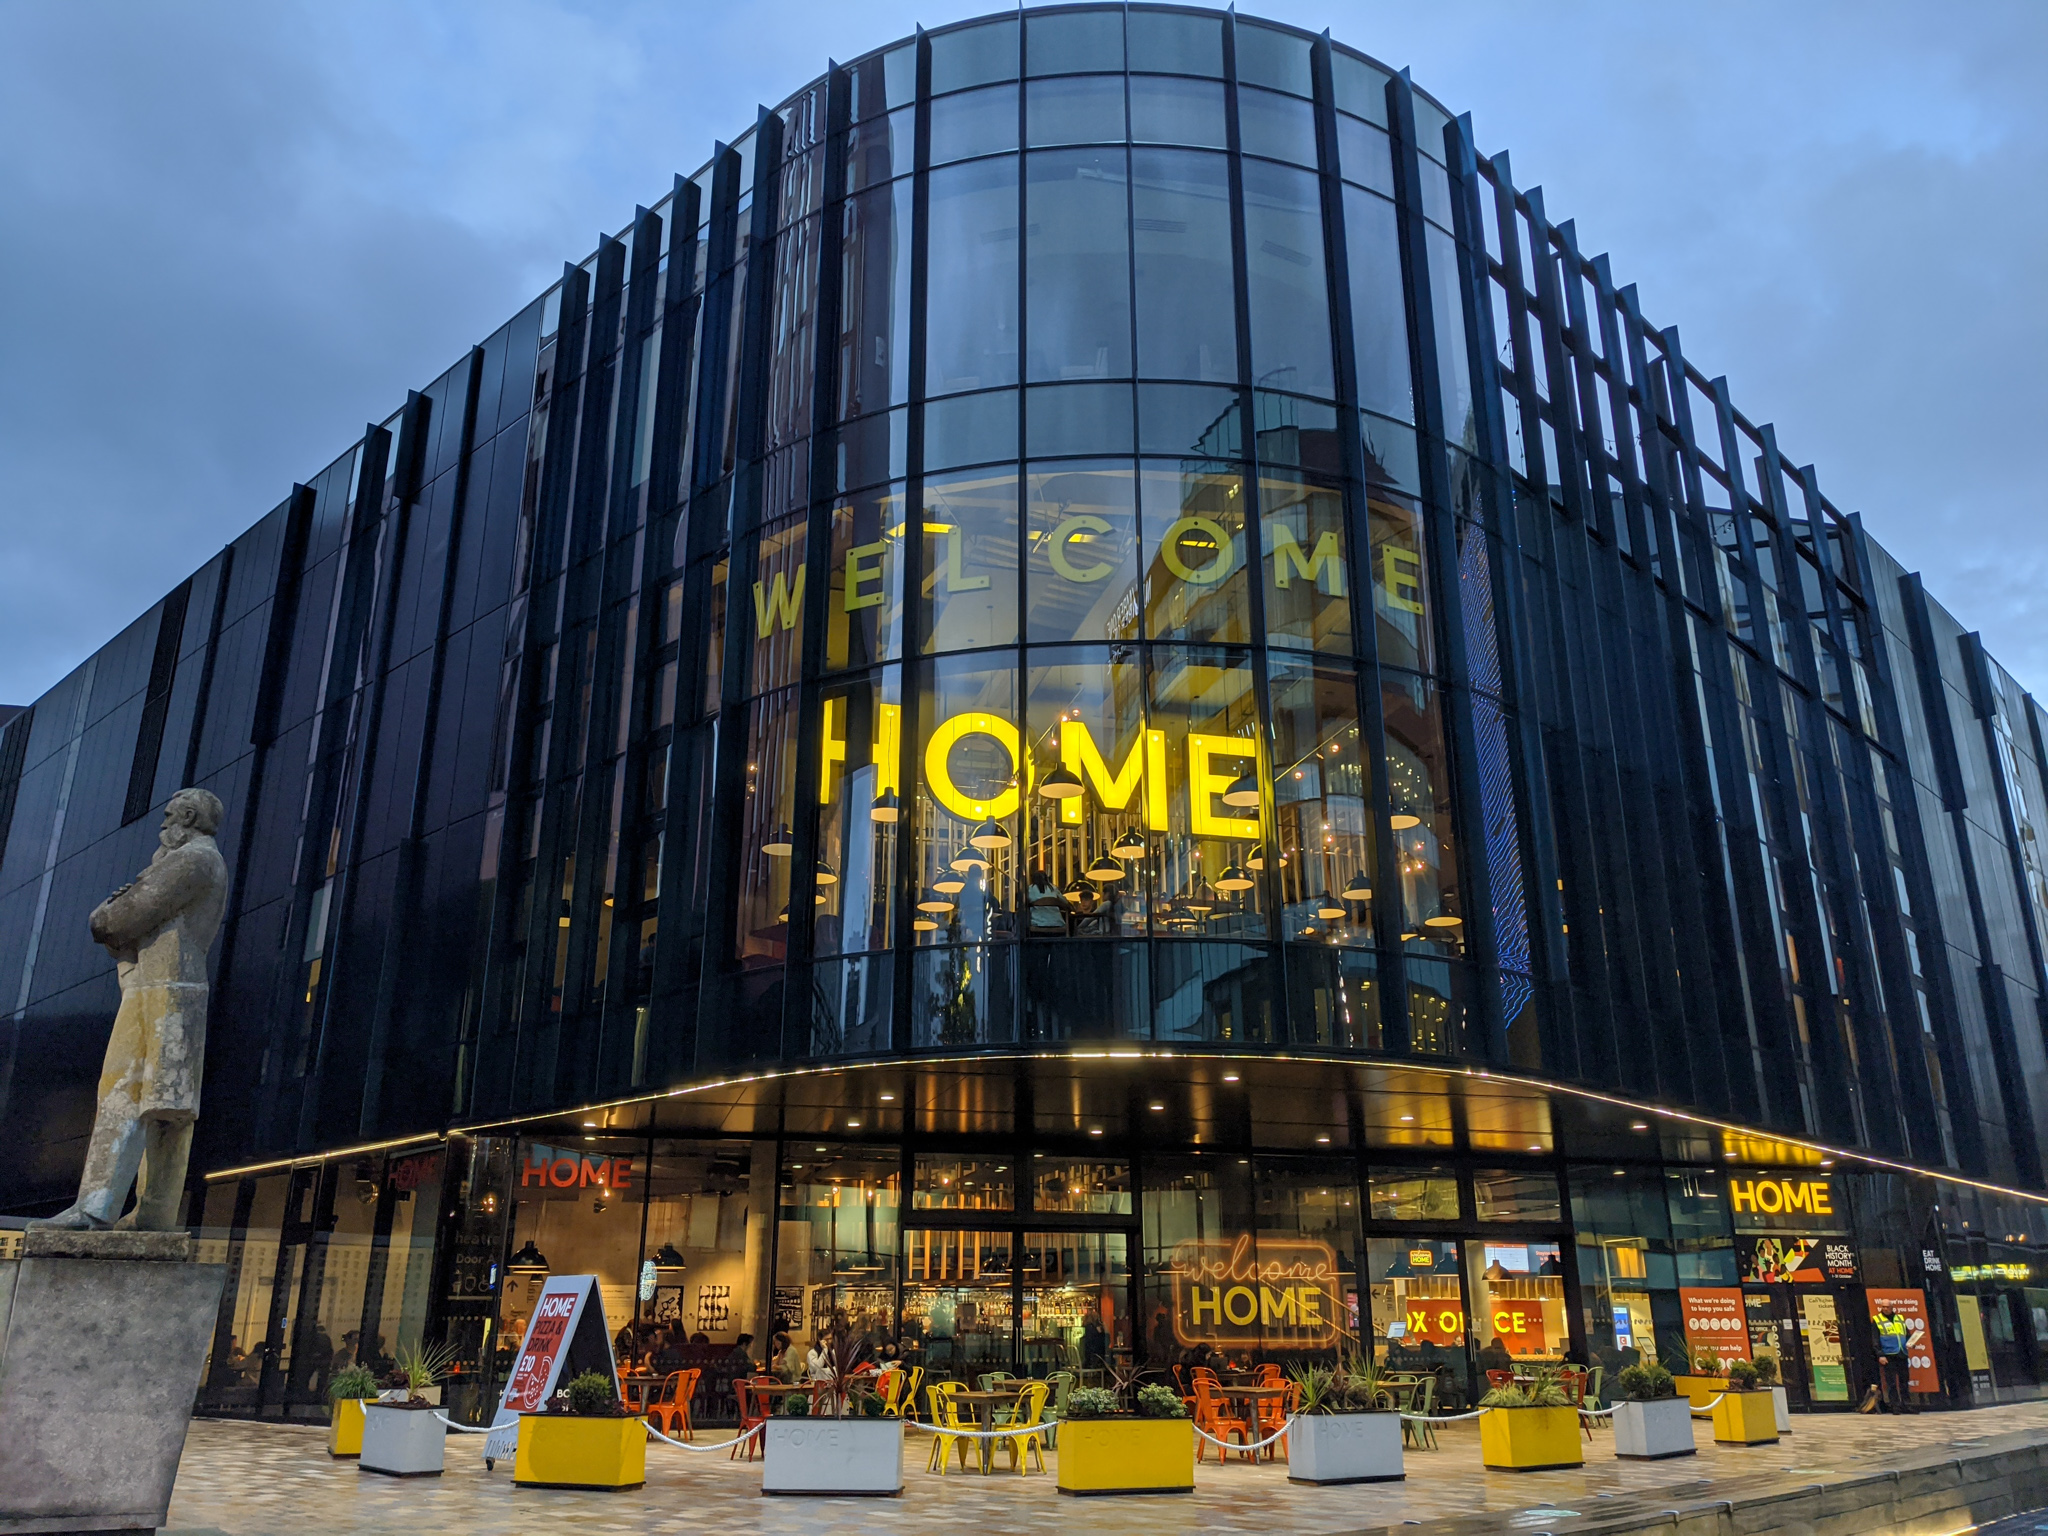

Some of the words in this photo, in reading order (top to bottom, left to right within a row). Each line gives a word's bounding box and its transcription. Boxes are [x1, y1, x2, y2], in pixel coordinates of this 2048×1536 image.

[753, 515, 1425, 639] WELCOME
[820, 699, 1262, 841] HOME
[522, 1158, 632, 1188] HOME
[1730, 1180, 1833, 1214] HOME
[456, 1253, 484, 1264] Door
[1171, 1234, 1337, 1281] welcome
[1825, 1252, 1851, 1260] HISTORY
[1827, 1259, 1853, 1267] MONTH
[1837, 1267, 1854, 1275] HOME
[1925, 1264, 1942, 1272] HOME
[540, 1297, 575, 1318] HOME
[1191, 1286, 1323, 1326] HOME
[1698, 1305, 1712, 1313] keep
[1720, 1297, 1736, 1306] doing
[1904, 1298, 1918, 1306] doing
[533, 1320, 555, 1335] PIZZA
[555, 1321, 563, 1335] &
[527, 1337, 552, 1352] DRINK
[1730, 1344, 1742, 1352] help
[519, 1355, 536, 1371] £10
[770, 1428, 839, 1448] HOME
